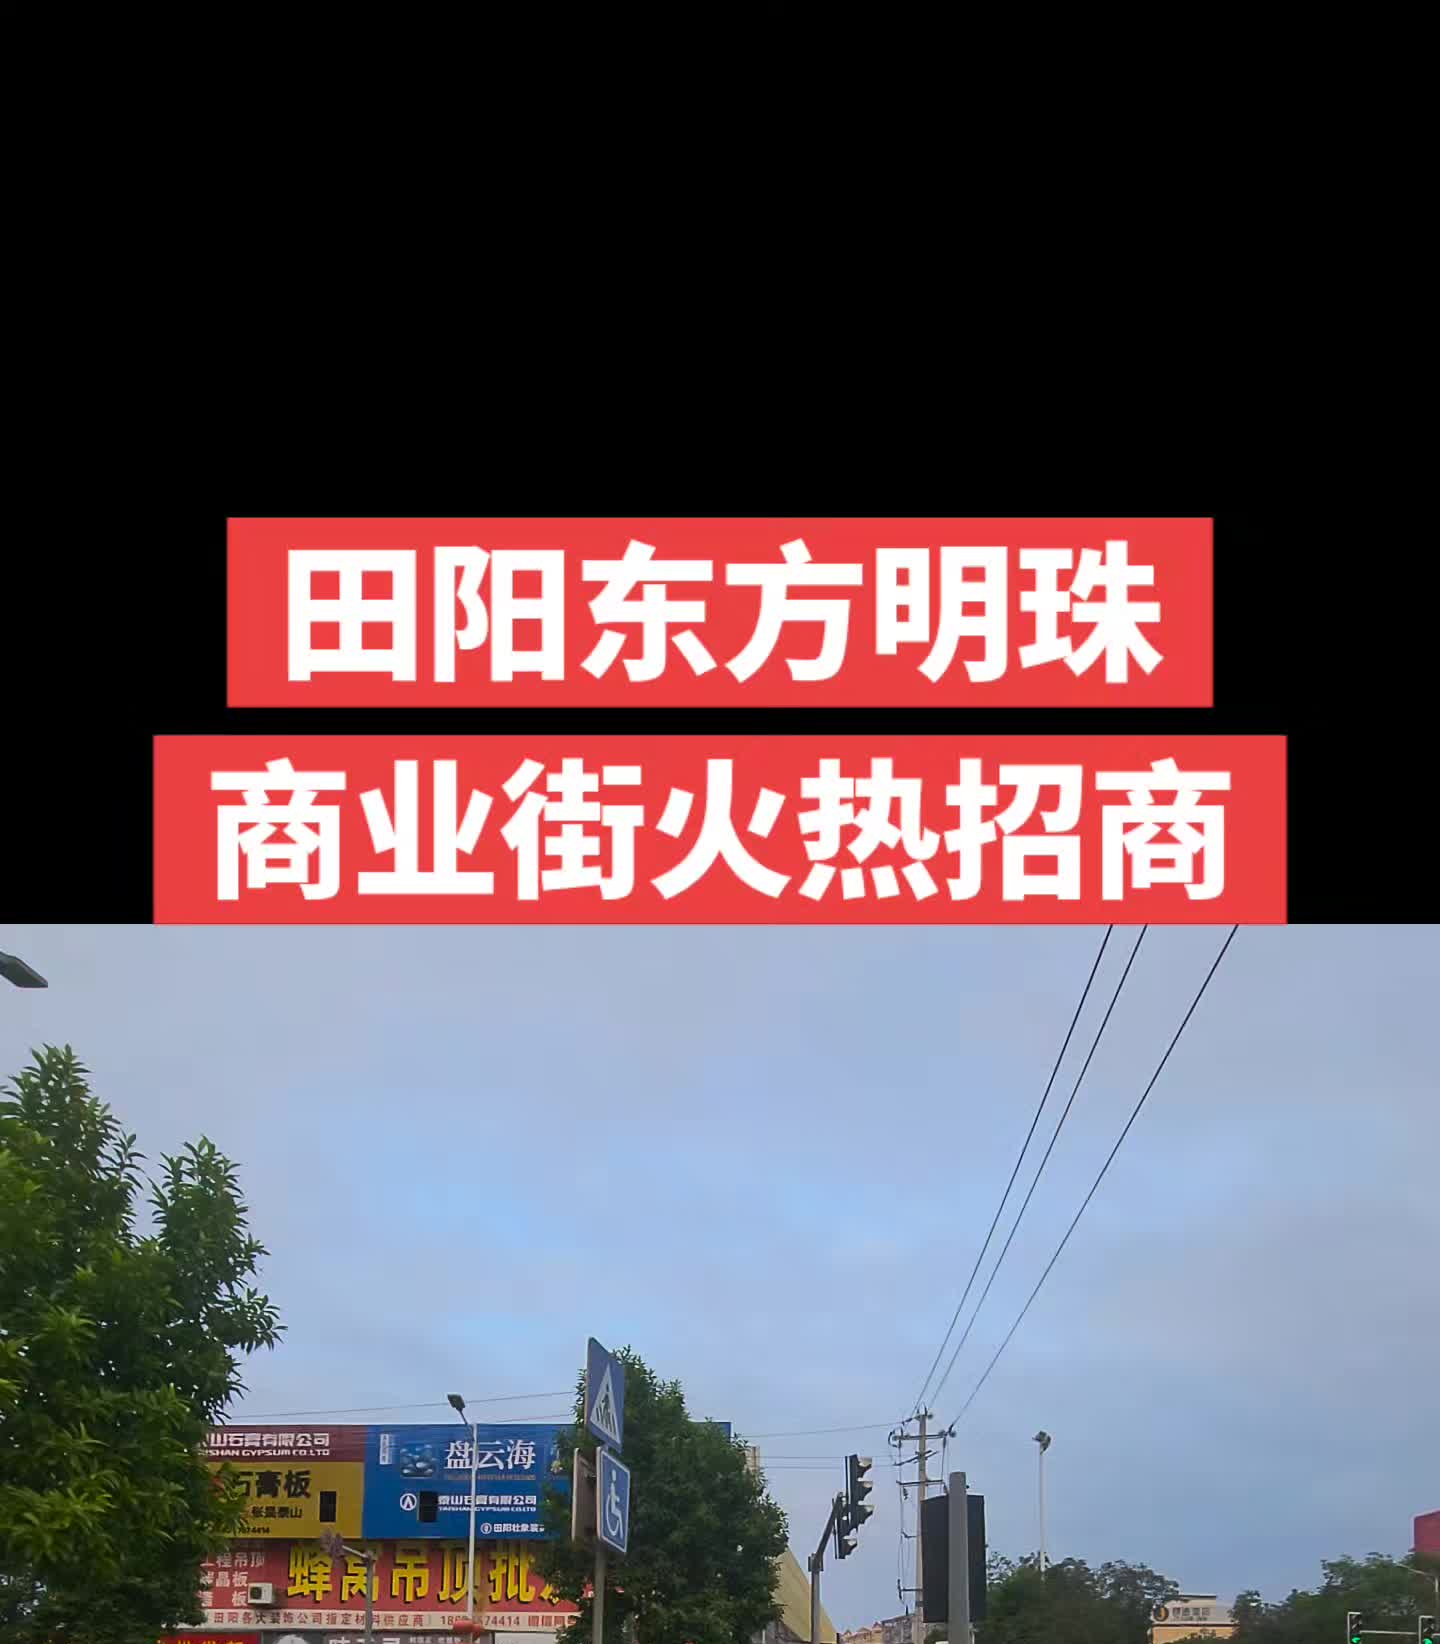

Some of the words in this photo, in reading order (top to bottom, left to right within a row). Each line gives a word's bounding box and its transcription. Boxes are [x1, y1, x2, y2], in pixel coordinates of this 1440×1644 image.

[444, 1439, 536, 1470] 盘云海
[287, 1541, 561, 1604] 蜂窝吊顶批
